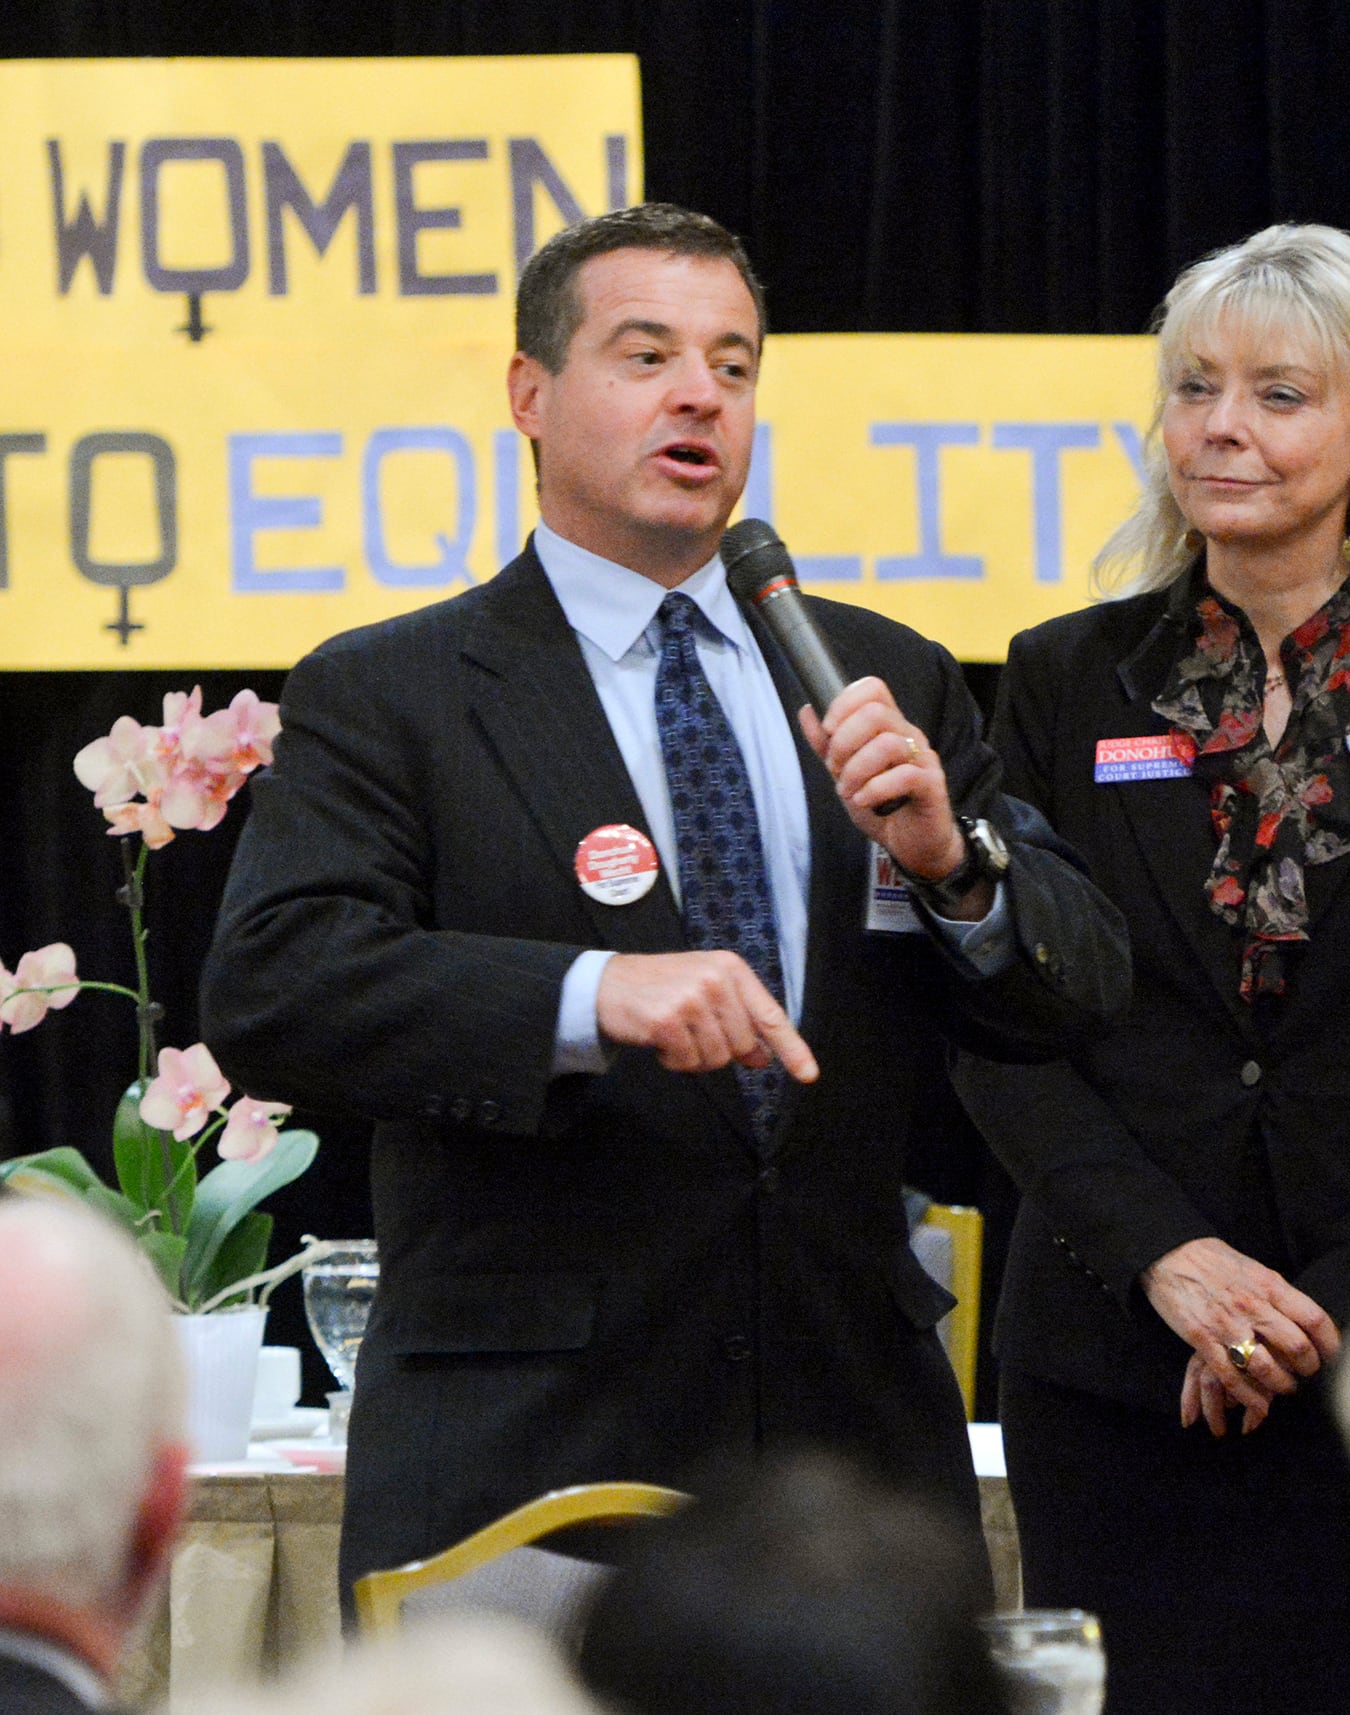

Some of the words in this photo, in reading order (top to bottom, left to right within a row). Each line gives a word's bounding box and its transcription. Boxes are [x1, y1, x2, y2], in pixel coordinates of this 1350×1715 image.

[45, 133, 628, 297] WOMEN
[226, 418, 1155, 595] EQLIT
[1098, 746, 1175, 763] DONOHU
[1097, 771, 1137, 781] COURT
[1103, 762, 1127, 773] FOR
